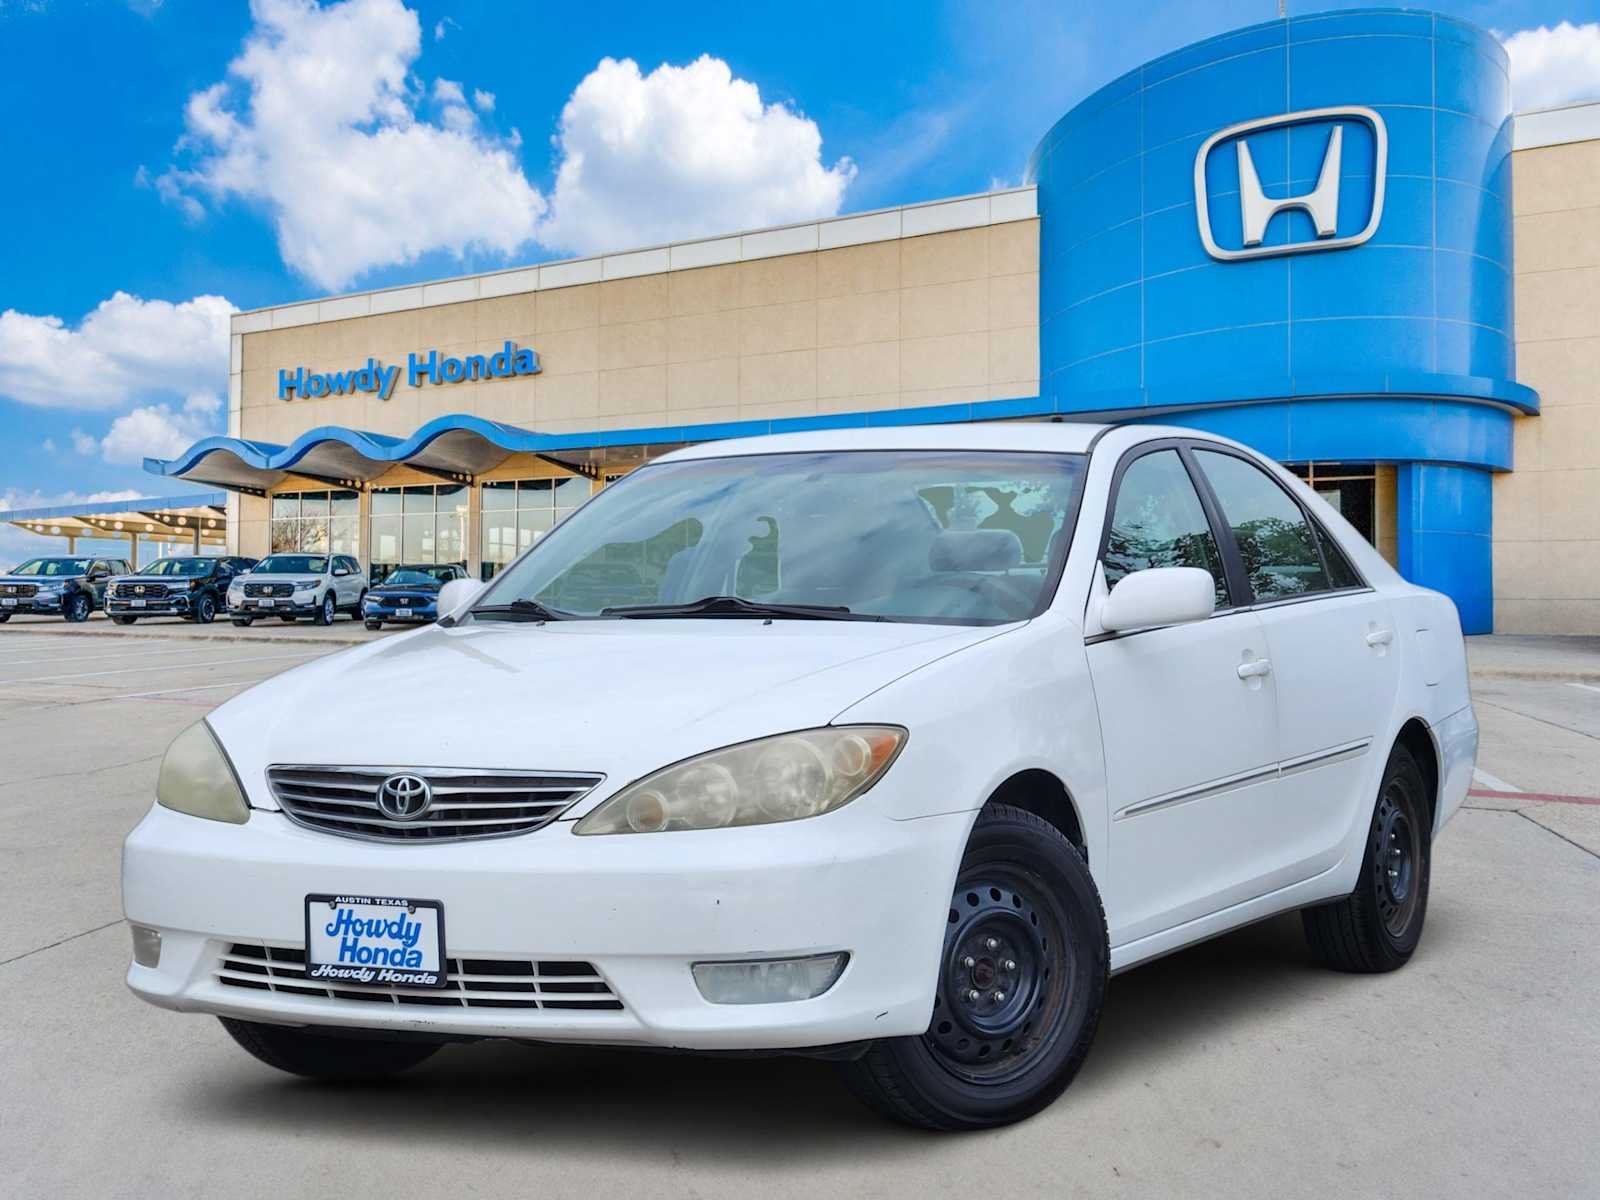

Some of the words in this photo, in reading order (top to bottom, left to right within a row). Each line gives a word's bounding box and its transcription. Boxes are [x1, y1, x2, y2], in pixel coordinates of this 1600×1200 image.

[278, 358, 400, 401] Howdy
[408, 340, 541, 388] Honda
[335, 896, 371, 905] AUSTIN
[374, 898, 409, 907] TEXAS
[325, 908, 422, 947] Howdy
[338, 936, 422, 969] Honda
[311, 965, 376, 982] Howdy
[377, 968, 438, 985] Honda
